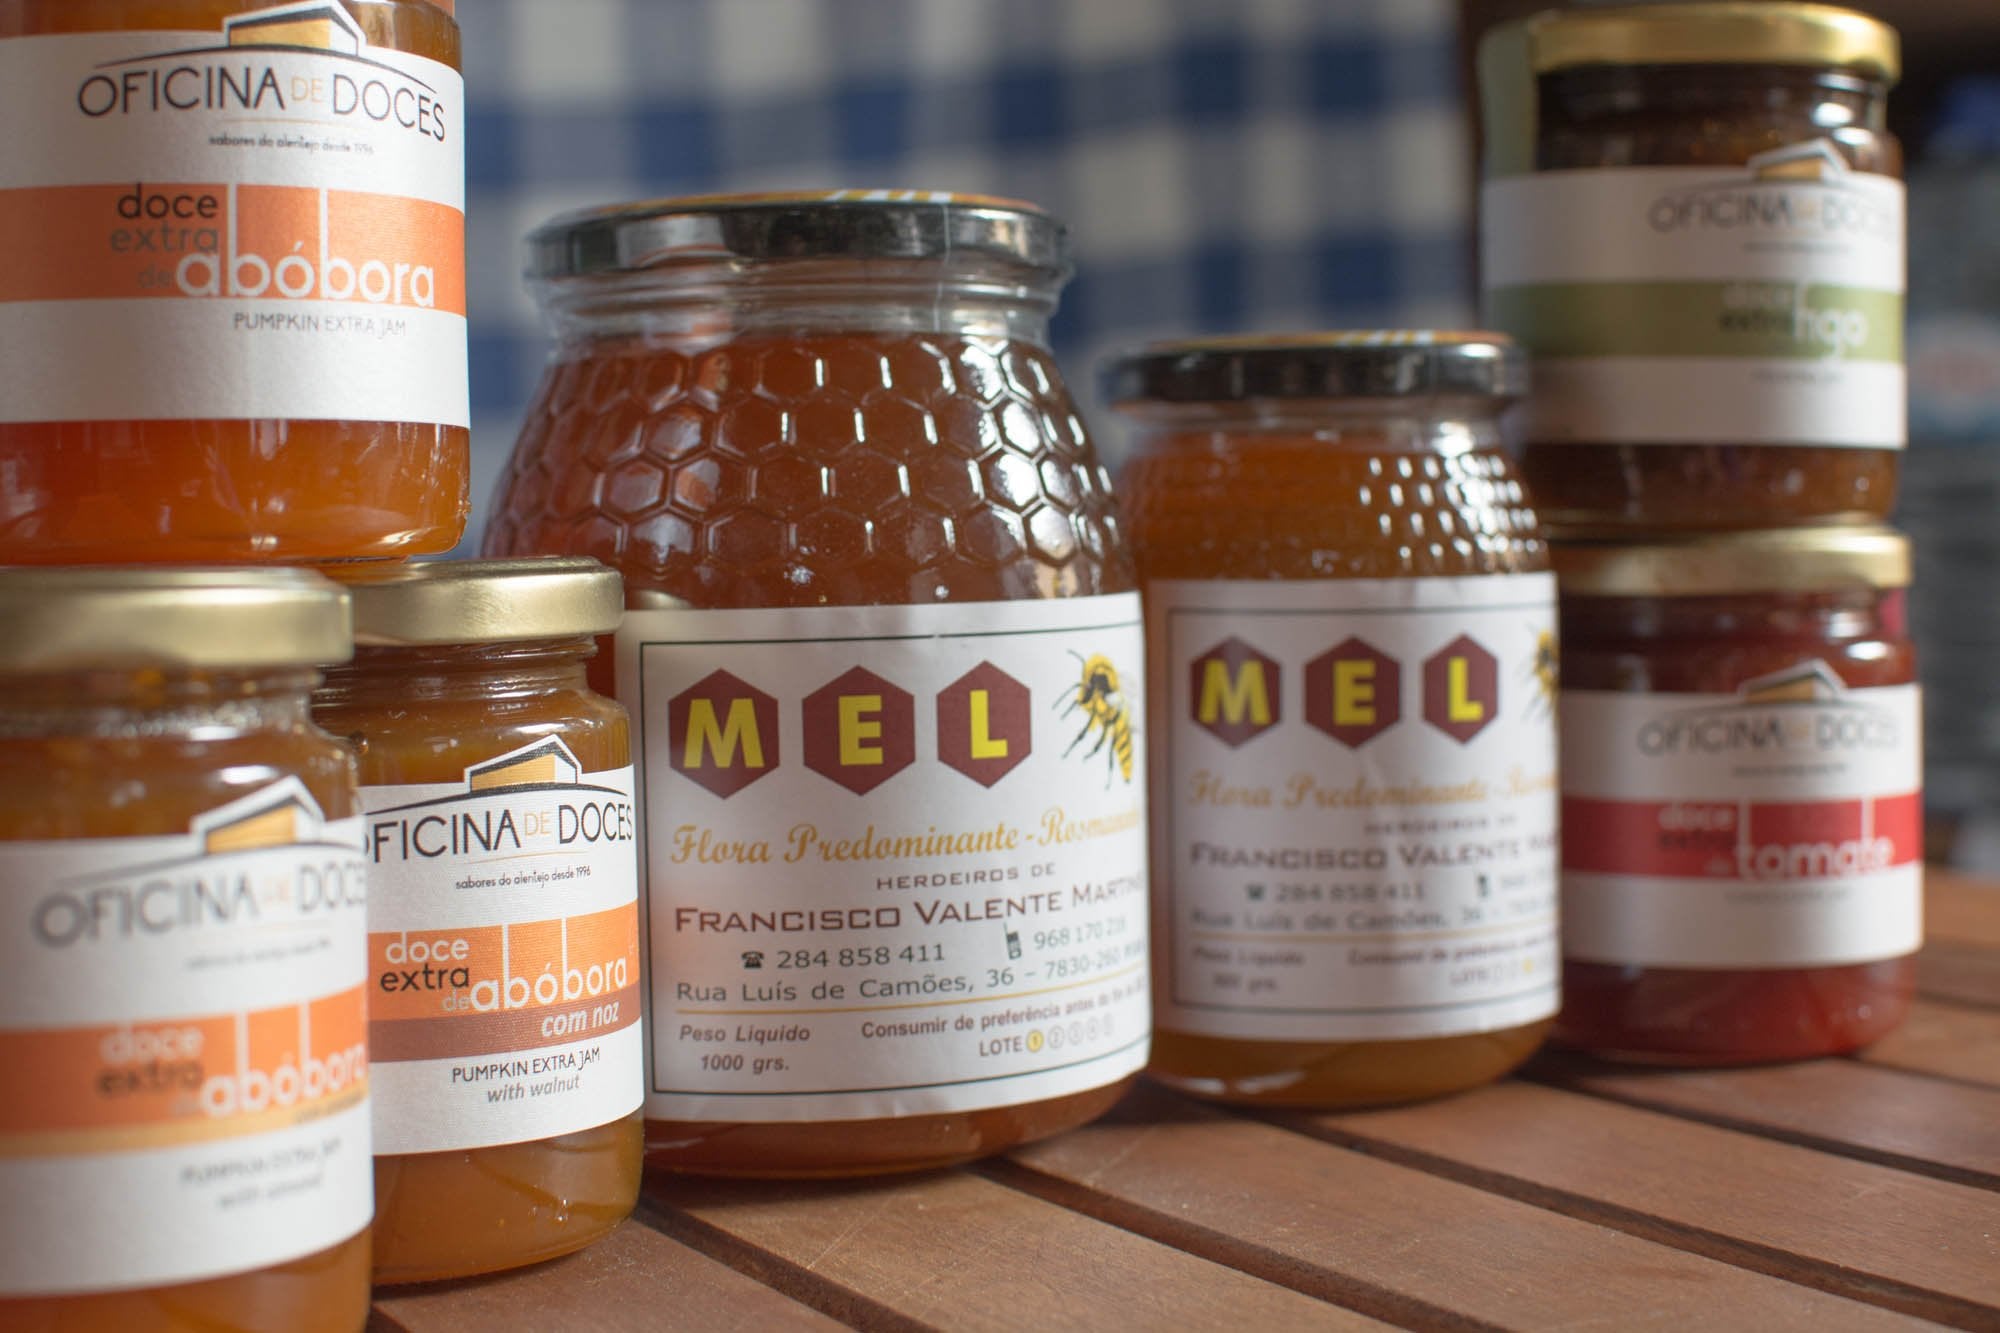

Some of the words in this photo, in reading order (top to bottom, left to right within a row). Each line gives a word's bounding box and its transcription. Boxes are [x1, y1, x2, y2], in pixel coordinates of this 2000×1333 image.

[78, 66, 285, 117] OFICINA
[291, 76, 324, 104] DE
[333, 74, 446, 142] DOCES
[117, 184, 218, 220] doce
[110, 221, 218, 254] extra
[175, 185, 435, 308] abóbora
[233, 311, 319, 332] PUMPKIN
[324, 315, 375, 336] EXTRA
[376, 319, 406, 342] JAM
[364, 809, 522, 864] FICINA
[524, 811, 553, 837] DE
[558, 801, 633, 845] DOCES
[671, 824, 774, 865] Flora
[1188, 840, 1388, 870] FRANCISCO
[456, 874, 497, 890] sabores
[498, 874, 512, 888] do
[551, 868, 575, 883] desde
[876, 866, 1019, 891] HERDEIROS
[1030, 863, 1056, 878] DE
[30, 872, 260, 949] OFICINA
[675, 907, 901, 933] FRANCISCO
[913, 891, 1063, 925] VALENTE
[385, 932, 470, 965] doce
[1033, 926, 1071, 951] 968
[441, 987, 471, 1012] de
[470, 919, 627, 1012] abóbora
[777, 949, 829, 970] 284
[839, 946, 891, 967] 858
[899, 943, 945, 965] 411
[380, 962, 470, 993] extra
[677, 982, 727, 1002] Rua
[742, 980, 797, 1002] Luís
[811, 980, 845, 1000] de
[859, 974, 975, 999] Camões,
[986, 967, 1014, 989] 36
[541, 1009, 587, 1038] com
[592, 1001, 620, 1028] noz
[679, 1024, 727, 1042] Peso
[861, 1015, 947, 1039] Consumir
[954, 1014, 975, 1031] de
[980, 1001, 1061, 1034] preferência
[979, 1034, 1025, 1057] LOTE
[452, 1060, 528, 1083] PUMPKIN
[532, 1055, 576, 1075] EXTRA
[578, 1047, 601, 1070] JAM
[700, 1054, 744, 1072] 1000
[752, 1057, 790, 1076] grs.
[487, 1084, 525, 1103] with
[530, 1074, 580, 1097] walnut
